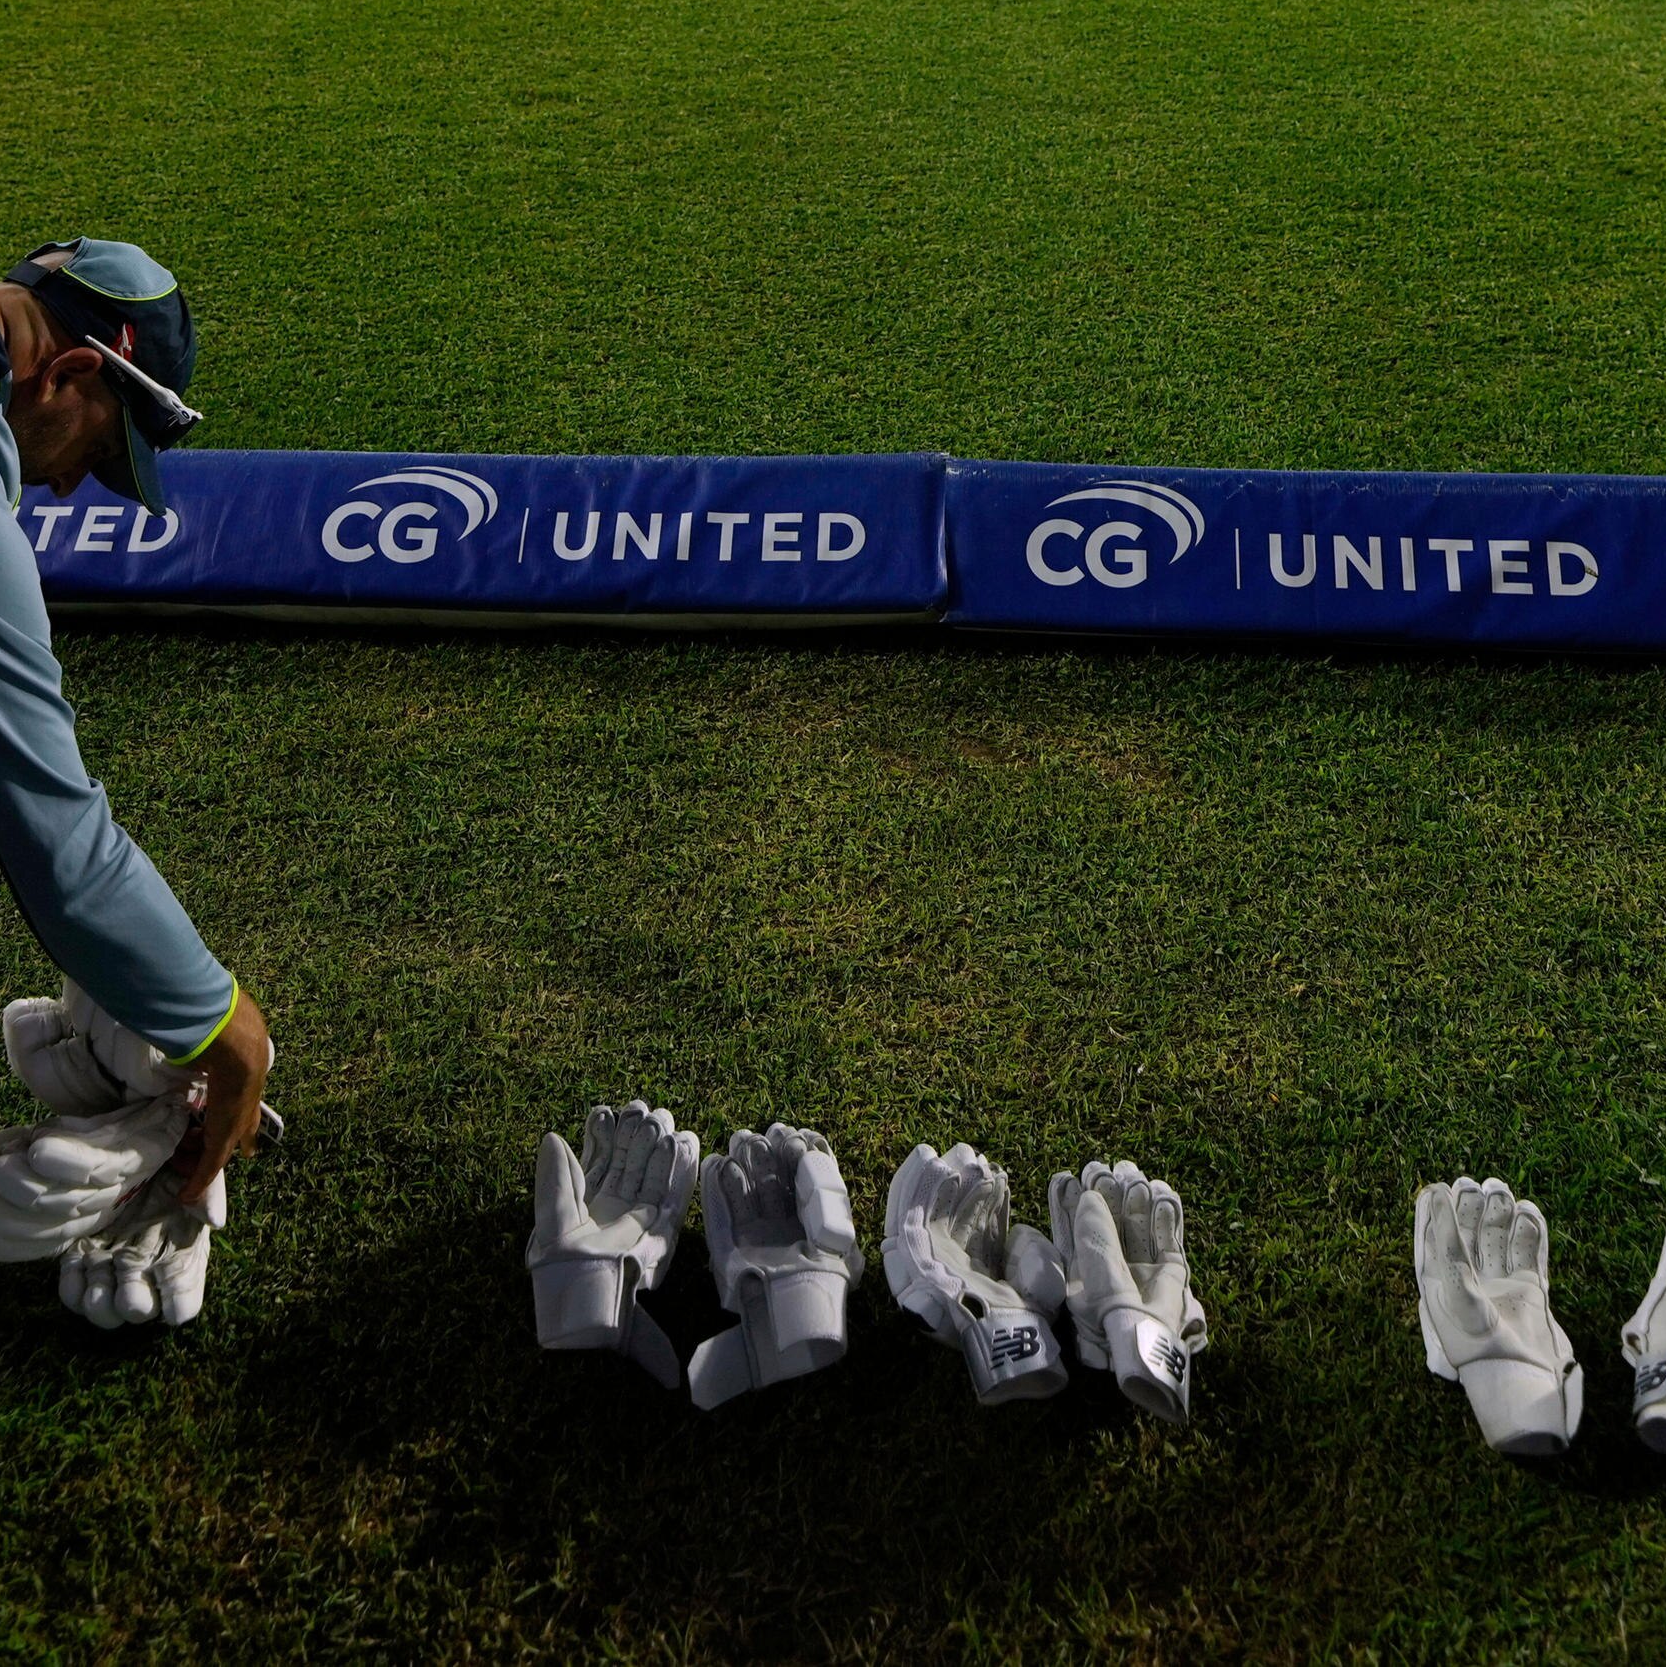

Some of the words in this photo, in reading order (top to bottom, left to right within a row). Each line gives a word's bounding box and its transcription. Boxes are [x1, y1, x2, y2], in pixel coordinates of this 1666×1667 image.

[17, 505, 181, 553] TED
[321, 501, 442, 565] CG
[553, 510, 867, 563] UNITED
[1026, 518, 1148, 589] CG
[1269, 533, 1600, 597] UNITED
